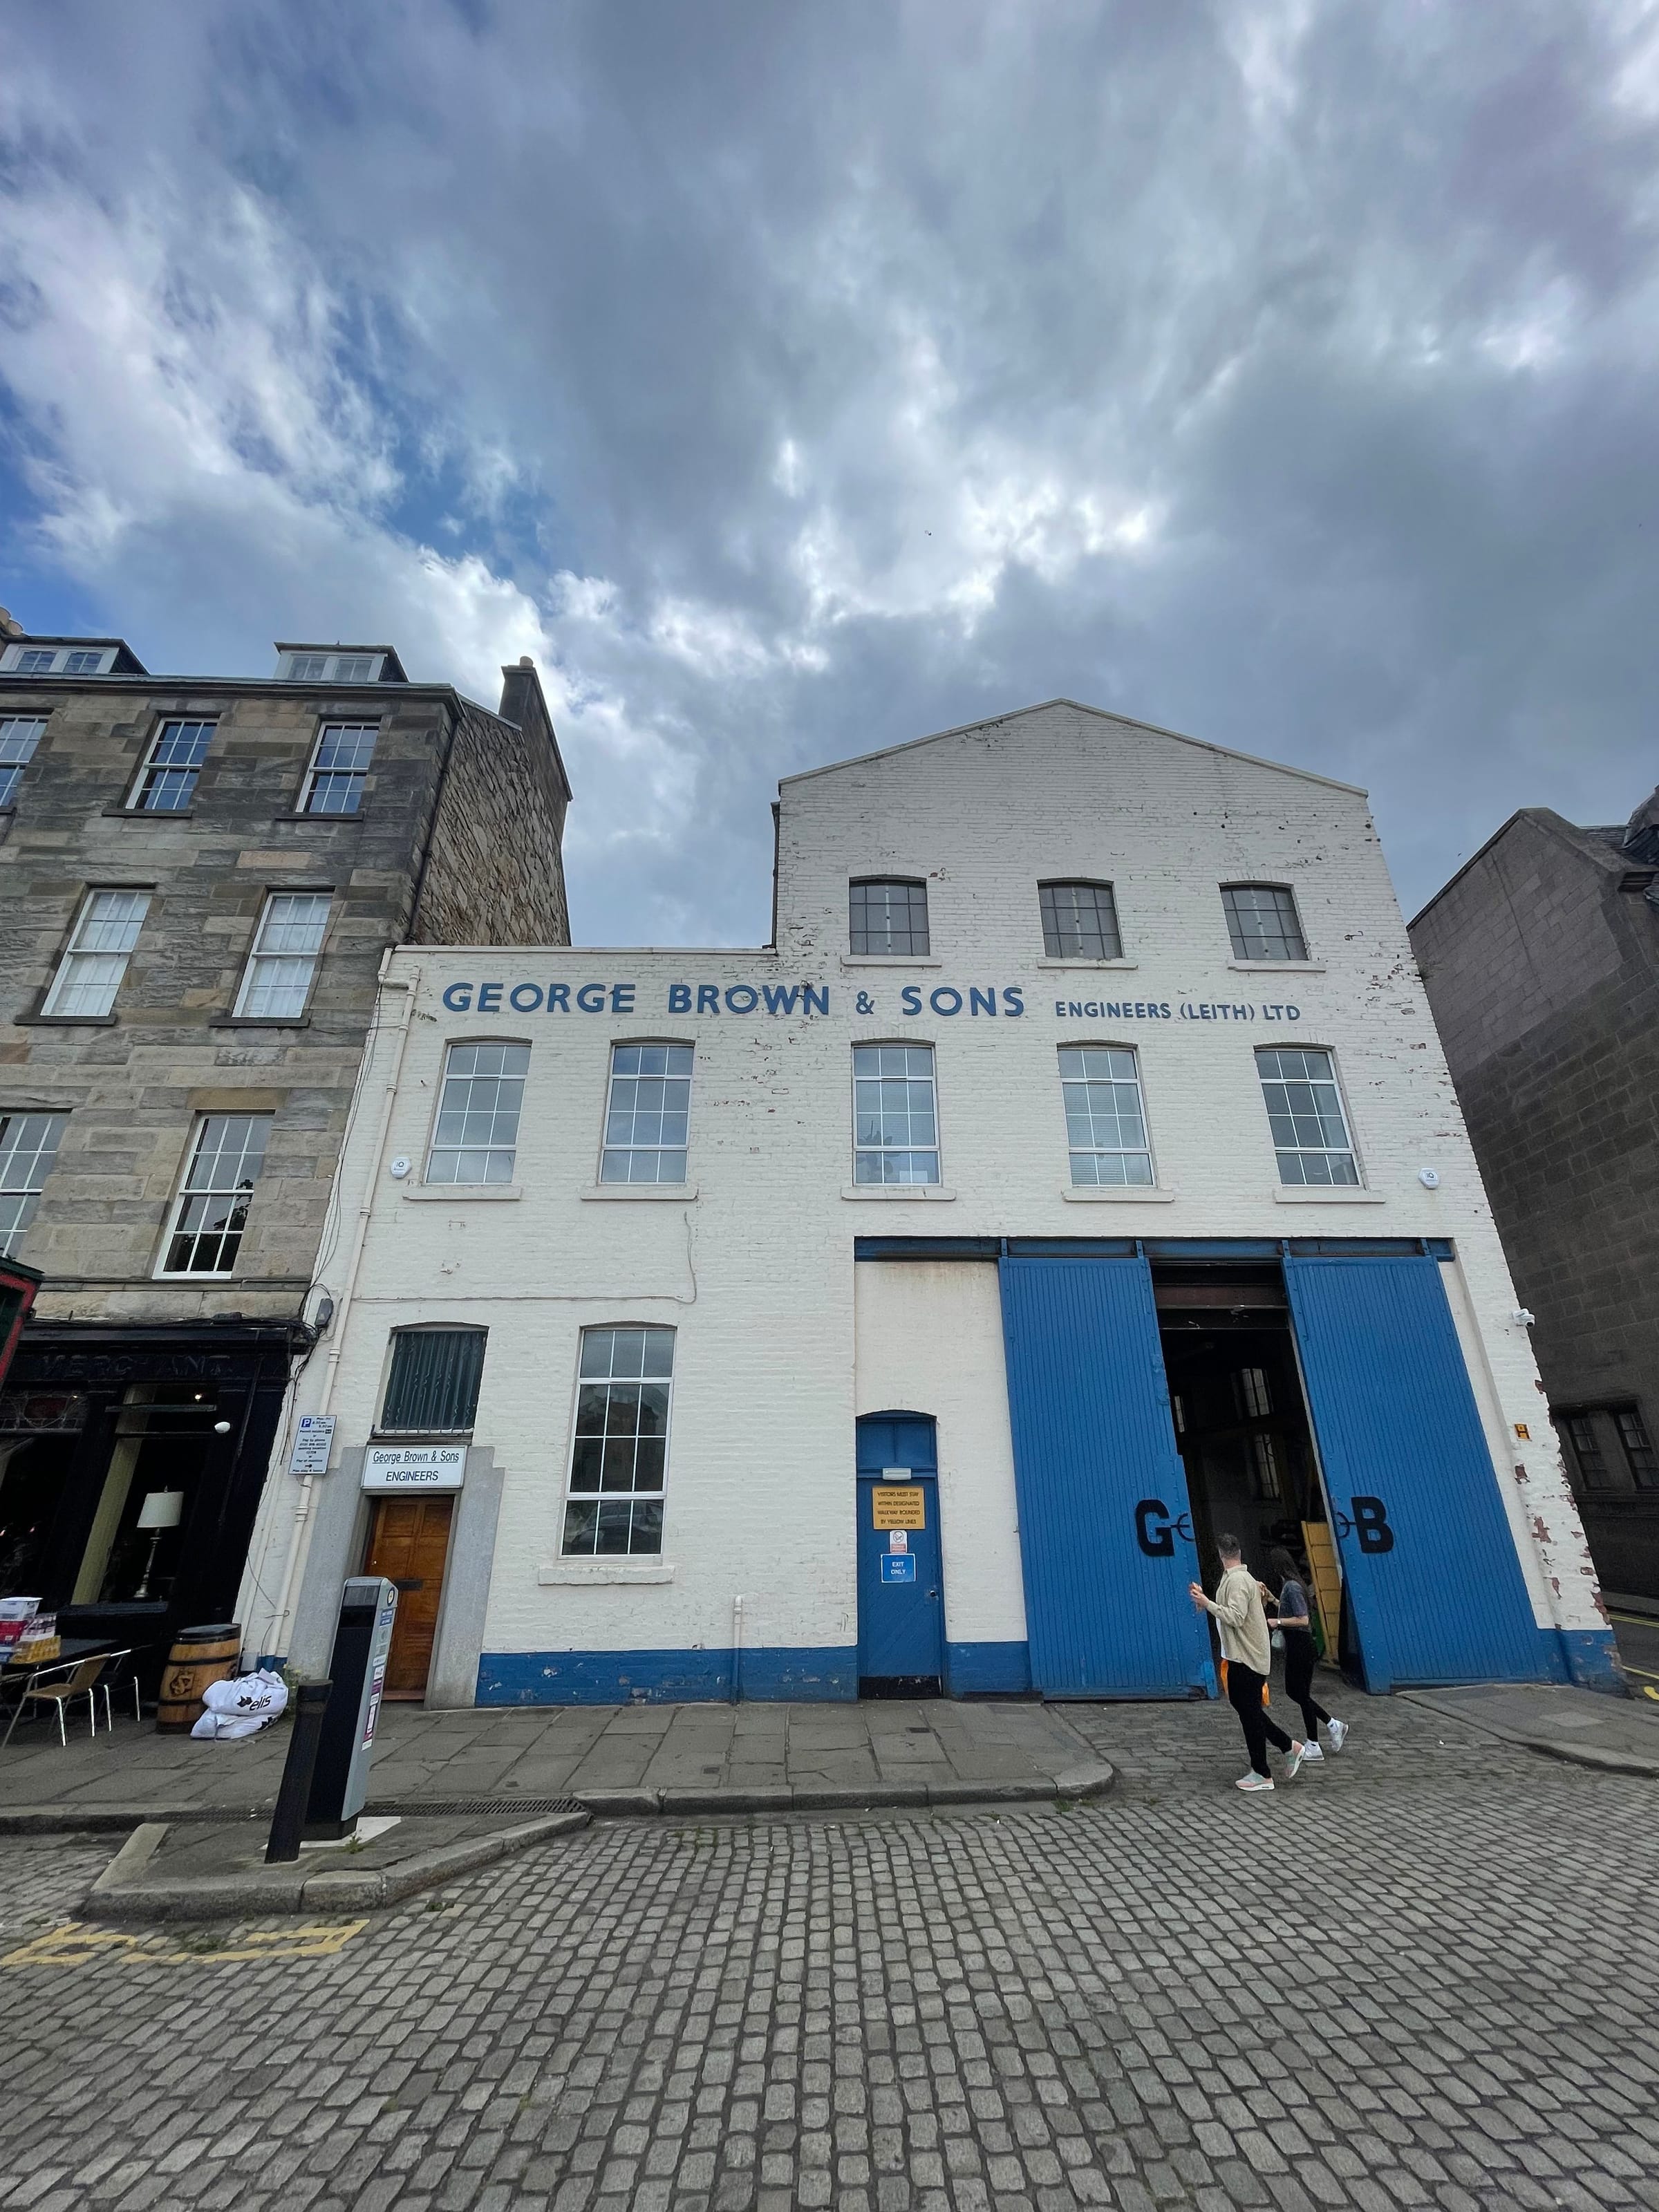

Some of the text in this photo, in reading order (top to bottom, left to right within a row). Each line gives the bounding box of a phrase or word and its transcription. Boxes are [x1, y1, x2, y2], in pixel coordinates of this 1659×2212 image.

[442, 982, 1301, 1021] GEORGE BROWN & SONS ENGINEERS (LEITH) LTD
[373, 1450, 460, 1464] George Brown & Sons
[386, 1471, 438, 1481] ENGINEERS
[1135, 1499, 1175, 1557] G
[1351, 1496, 1394, 1553] B
[250, 1695, 272, 1711] elis
